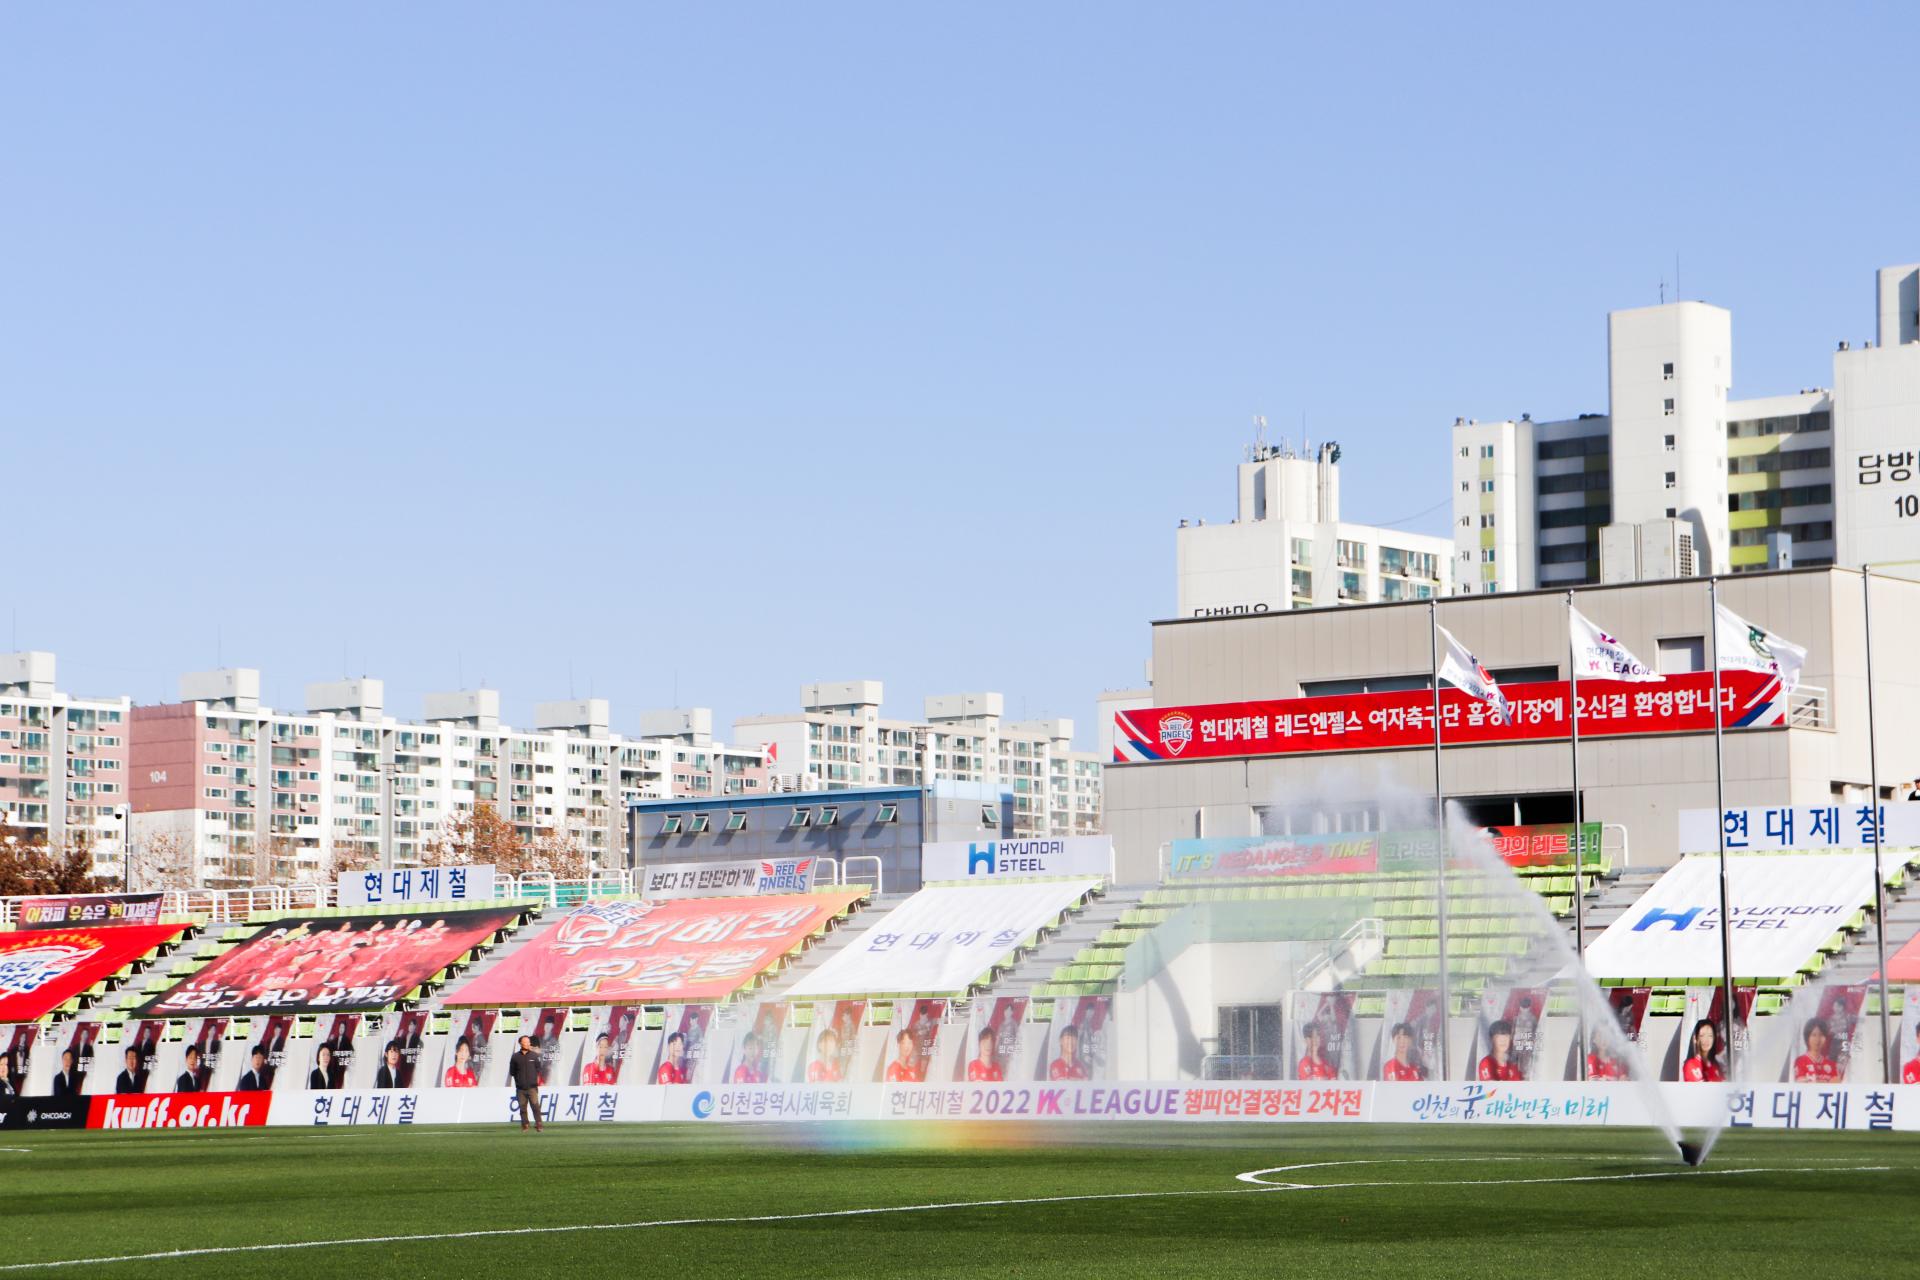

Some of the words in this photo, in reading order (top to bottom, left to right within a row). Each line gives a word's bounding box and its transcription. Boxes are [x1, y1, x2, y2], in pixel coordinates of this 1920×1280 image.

[1858, 452, 1920, 485] 담방
[1200, 715, 1268, 743] 현대제철
[1275, 710, 1362, 738] 레드엔젤스
[1368, 703, 1460, 732] 여자축구단
[1467, 697, 1563, 728] 홈경기장에
[1569, 692, 1627, 719] 오신걸
[1634, 686, 1736, 717] 환영합니다
[1162, 730, 1191, 740] ANGELS
[150, 770, 167, 783] 104
[1724, 806, 1885, 847] 현대제철
[1000, 841, 1064, 856] HYUNDAI
[1329, 838, 1373, 858] TIME
[776, 861, 794, 876] RED
[1000, 858, 1046, 872] STEEL
[364, 868, 467, 903] 현대제철
[650, 869, 677, 892] 보다
[681, 868, 696, 889] 더
[759, 874, 806, 893] ANGELS
[26, 906, 66, 923] 어차피
[69, 905, 106, 921] 우승은
[1706, 904, 1844, 917] HYUNDAI
[1695, 919, 1789, 931] STEEL
[867, 928, 1026, 952] 현대제철
[103, 1096, 250, 1129] kwff.or.kr
[314, 1094, 417, 1126] 현대제철
[720, 1090, 853, 1116] 인천광역시체육회
[890, 1089, 964, 1116] 현대제철
[969, 1088, 1030, 1114] 2022
[1074, 1088, 1180, 1115] LEAGUE
[1184, 1088, 1303, 1116] 챔피언결정전
[1306, 1088, 1363, 1116] 2차전
[1413, 1094, 1458, 1120] 인천의
[1486, 1092, 1560, 1120] 대한민국의
[1565, 1095, 1609, 1124] 미래
[1726, 1090, 1895, 1131] 현대제철
